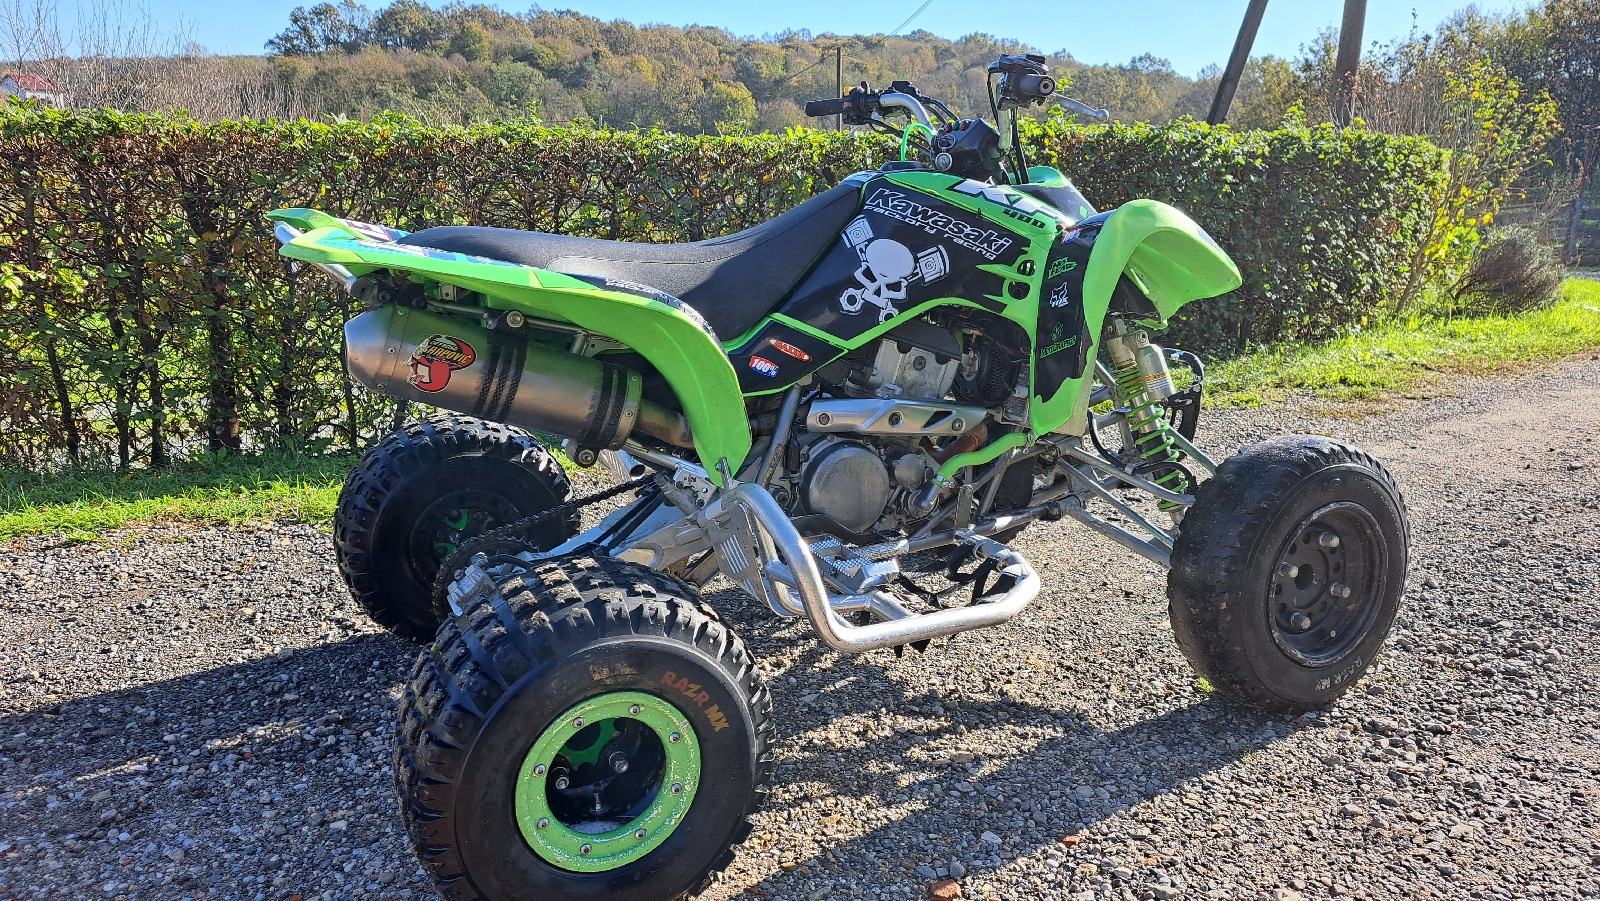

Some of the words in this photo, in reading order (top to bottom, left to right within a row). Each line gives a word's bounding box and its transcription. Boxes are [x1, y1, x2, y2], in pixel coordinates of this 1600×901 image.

[866, 188, 1012, 254] Kawasaki
[1003, 208, 1046, 228] 400
[944, 233, 997, 260] racing
[751, 358, 779, 376] 100%
[661, 671, 710, 707] RAZR
[703, 704, 730, 733] MX
